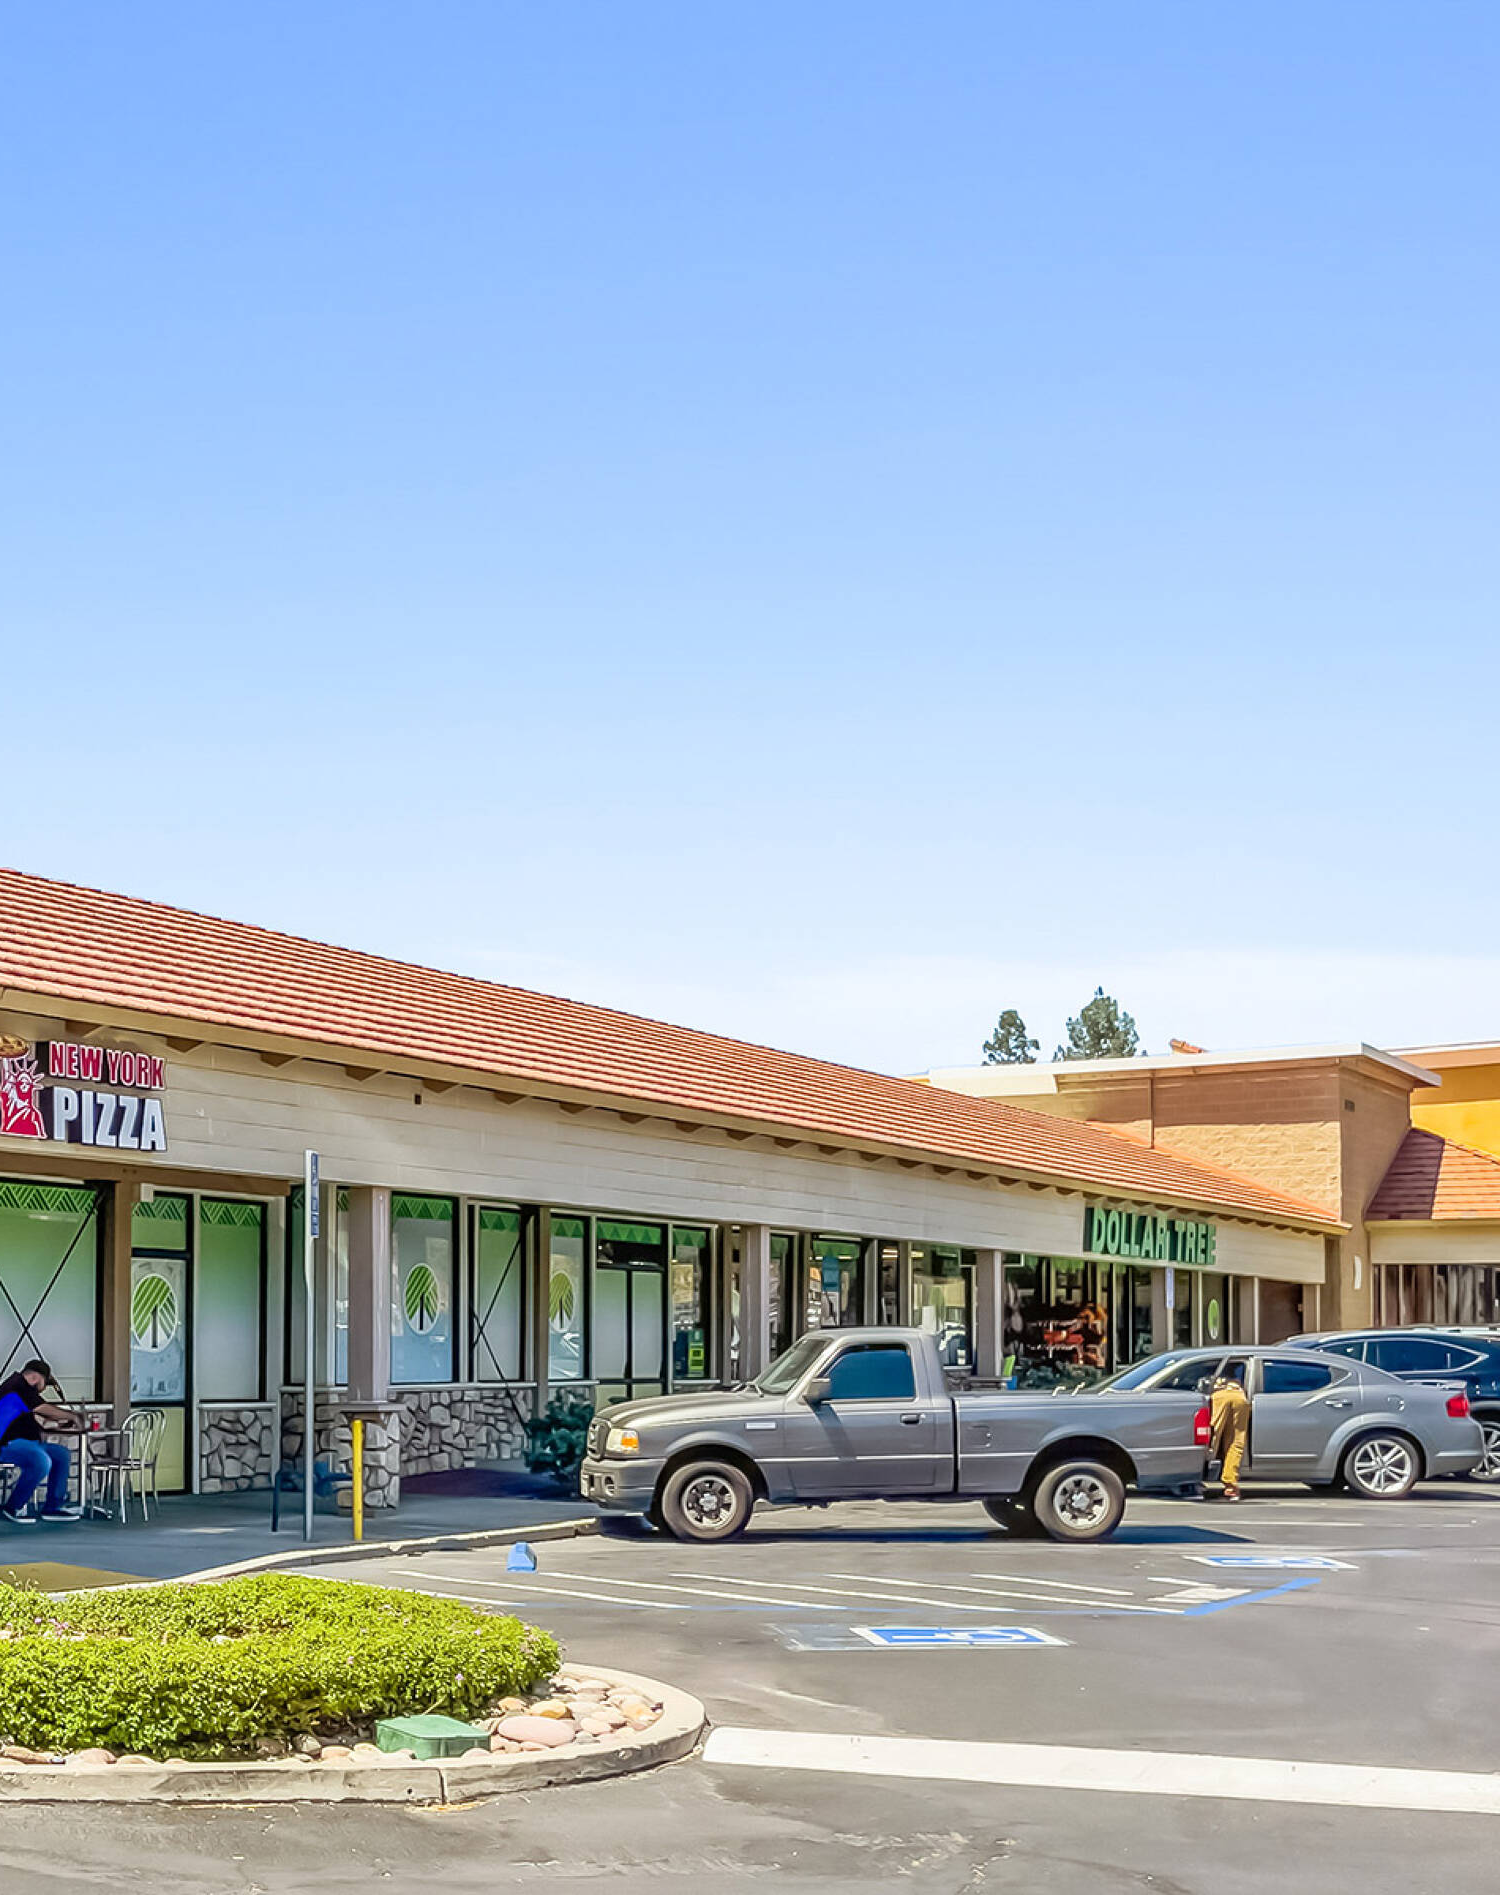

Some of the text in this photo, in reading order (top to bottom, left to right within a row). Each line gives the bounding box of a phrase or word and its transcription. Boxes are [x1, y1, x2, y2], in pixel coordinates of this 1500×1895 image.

[49, 1040, 166, 1091] NEW YORK
[53, 1086, 168, 1151] PIZZA
[1091, 1206, 1217, 1265] DOLLAR TREE
